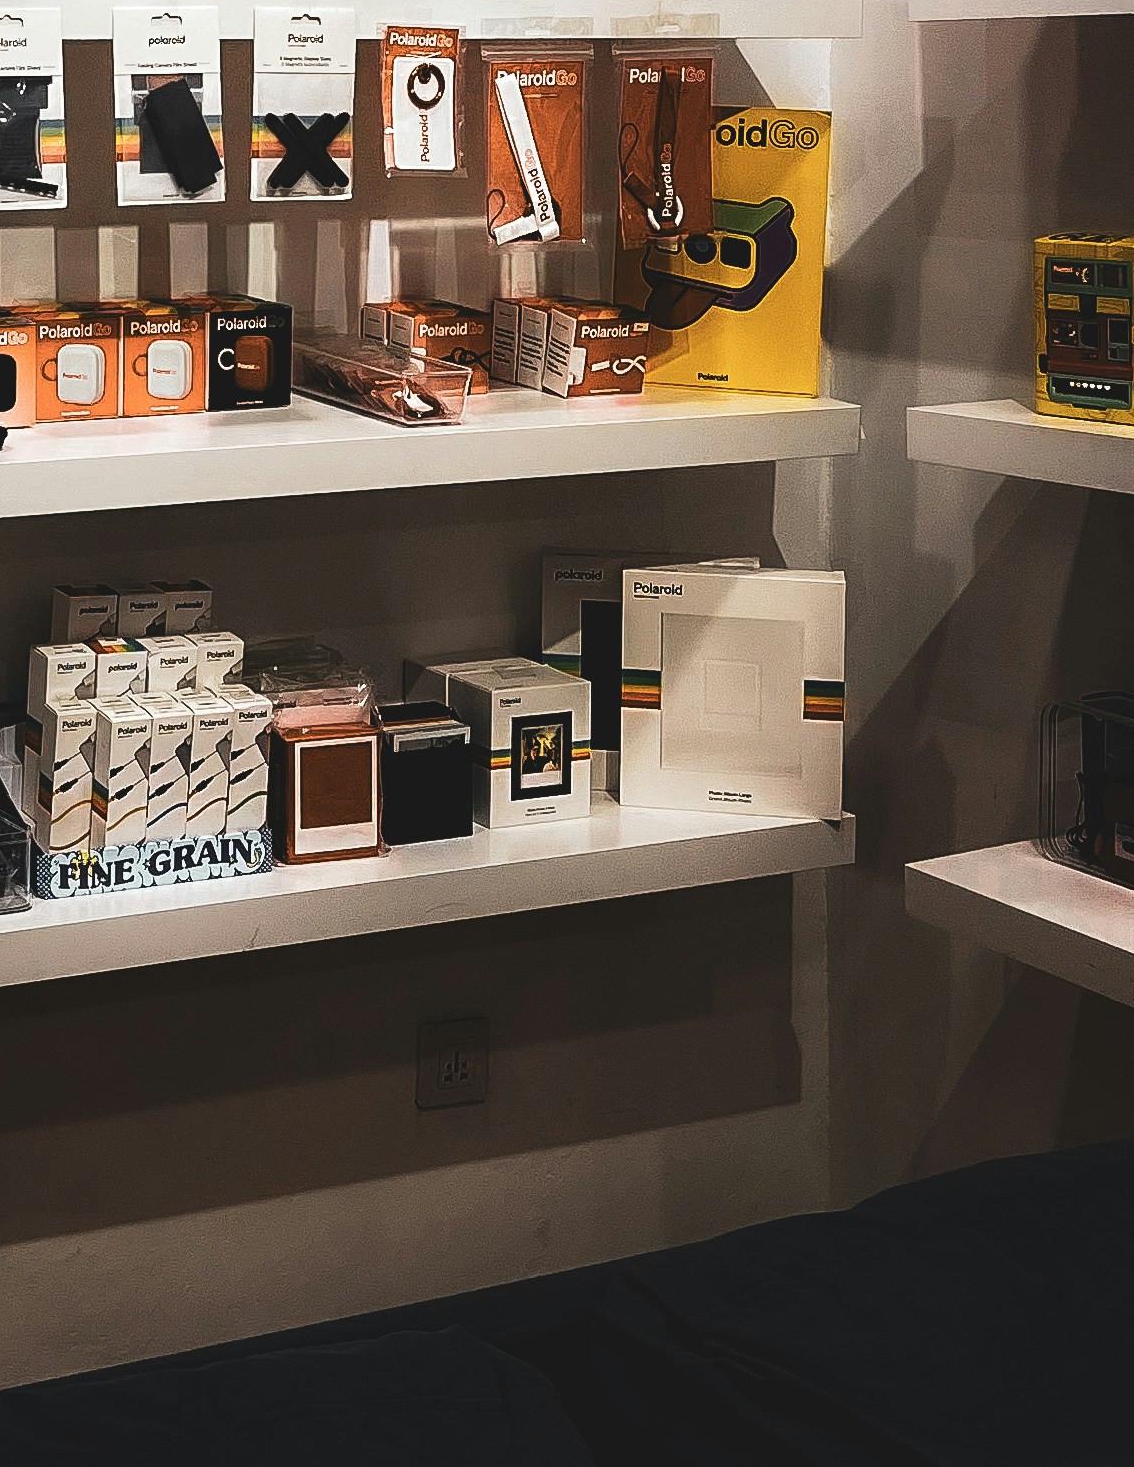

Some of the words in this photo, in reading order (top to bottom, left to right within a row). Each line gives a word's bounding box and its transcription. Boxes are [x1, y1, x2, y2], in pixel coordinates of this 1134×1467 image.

[148, 35, 186, 47] polaroid
[287, 33, 324, 43] Polaroid
[389, 31, 454, 48] PolaroidGo
[497, 70, 578, 87] PlaroidGo
[420, 114, 430, 163] Polaroid
[716, 117, 819, 150] oidGo
[524, 148, 551, 223] PolaroidGo
[660, 143, 672, 218] PolaroidGo
[130, 318, 198, 335] PolaroidGo
[217, 315, 285, 331] PolaroidGo
[39, 321, 113, 339] PolaroidGo
[419, 322, 485, 338] PolaroidGo
[697, 372, 729, 382] Polaroid
[554, 569, 603, 581] polaroid
[633, 582, 683, 596] Polaroid
[78, 605, 109, 615] polaroid
[129, 600, 159, 611] Polaroid
[174, 600, 204, 611] polaroid
[207, 649, 235, 659] Polaroid
[57, 661, 87, 672] Polaroid
[160, 656, 189, 666] Polaroid
[107, 662, 138, 673] polaroid
[238, 710, 268, 720] Polaroid
[62, 718, 92, 729] Polaroid
[158, 722, 188, 732] Polaroid
[199, 718, 229, 728] Polaroid
[117, 725, 148, 735] Polaroid
[58, 858, 136, 890] FINE
[147, 837, 257, 877] GRAIN
